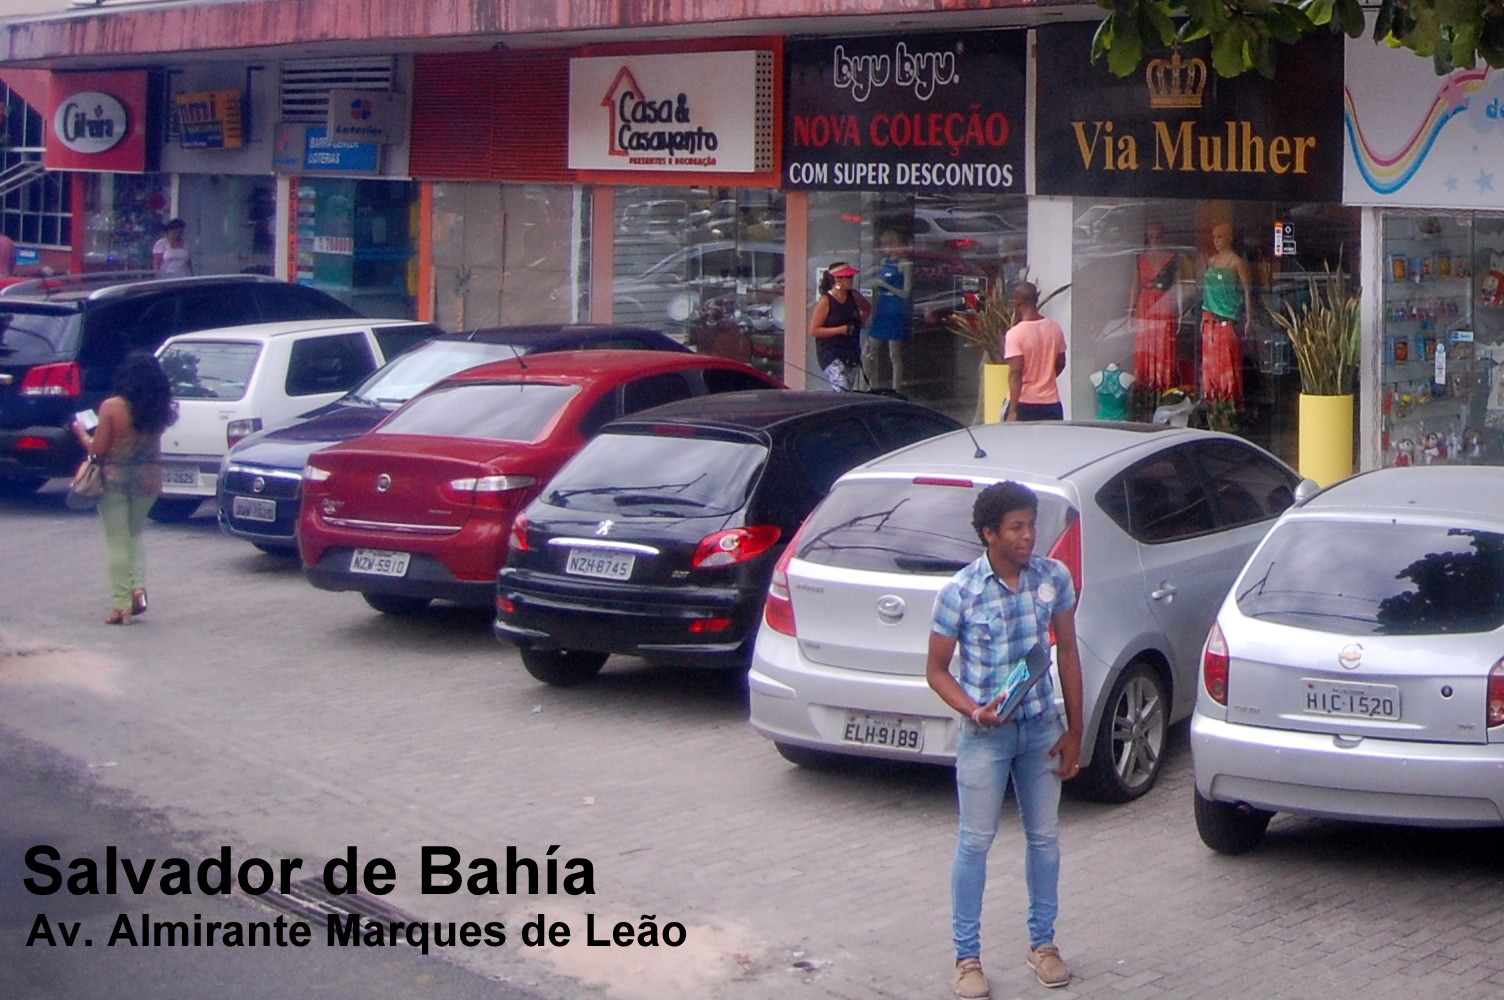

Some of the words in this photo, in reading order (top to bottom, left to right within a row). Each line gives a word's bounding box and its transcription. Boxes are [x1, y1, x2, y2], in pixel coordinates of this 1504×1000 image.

[619, 91, 673, 123] Casa
[675, 92, 690, 123] &
[794, 114, 862, 147] NOVA
[870, 103, 1009, 156] COLEÇÃO
[308, 153, 341, 164] LOTERIAS
[1071, 120, 1140, 171] Via
[1152, 121, 1316, 174] Mulher
[789, 162, 828, 184] COM
[834, 162, 889, 185] SUPER
[896, 163, 1013, 187] DESCONTOS
